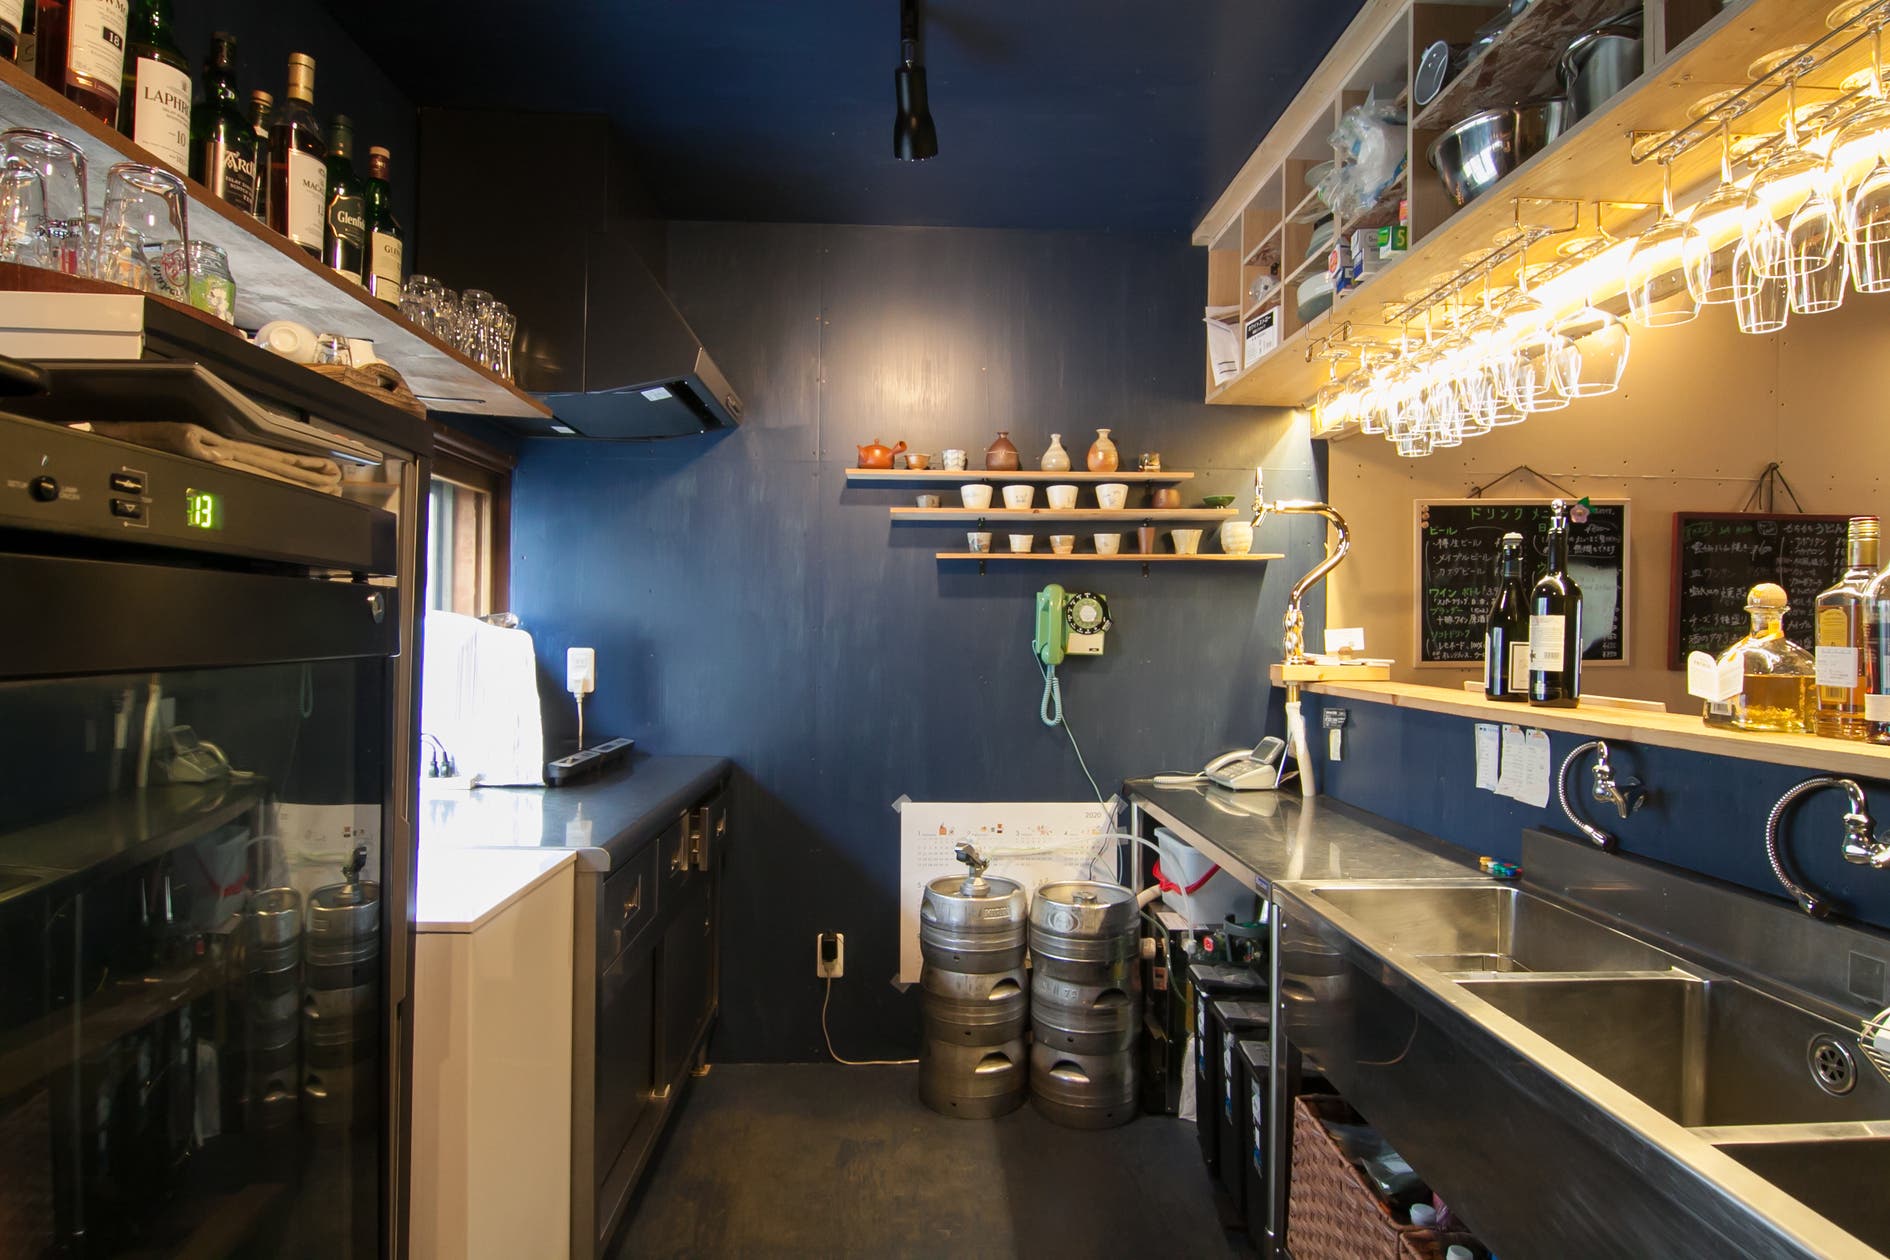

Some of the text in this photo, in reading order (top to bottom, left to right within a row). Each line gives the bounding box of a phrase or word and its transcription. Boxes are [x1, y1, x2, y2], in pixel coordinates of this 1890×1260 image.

[109, 32, 120, 47] 18
[144, 86, 189, 116] LAPHR
[177, 130, 187, 148] 10
[195, 495, 212, 528] 13
[1085, 811, 1101, 819] 2020
